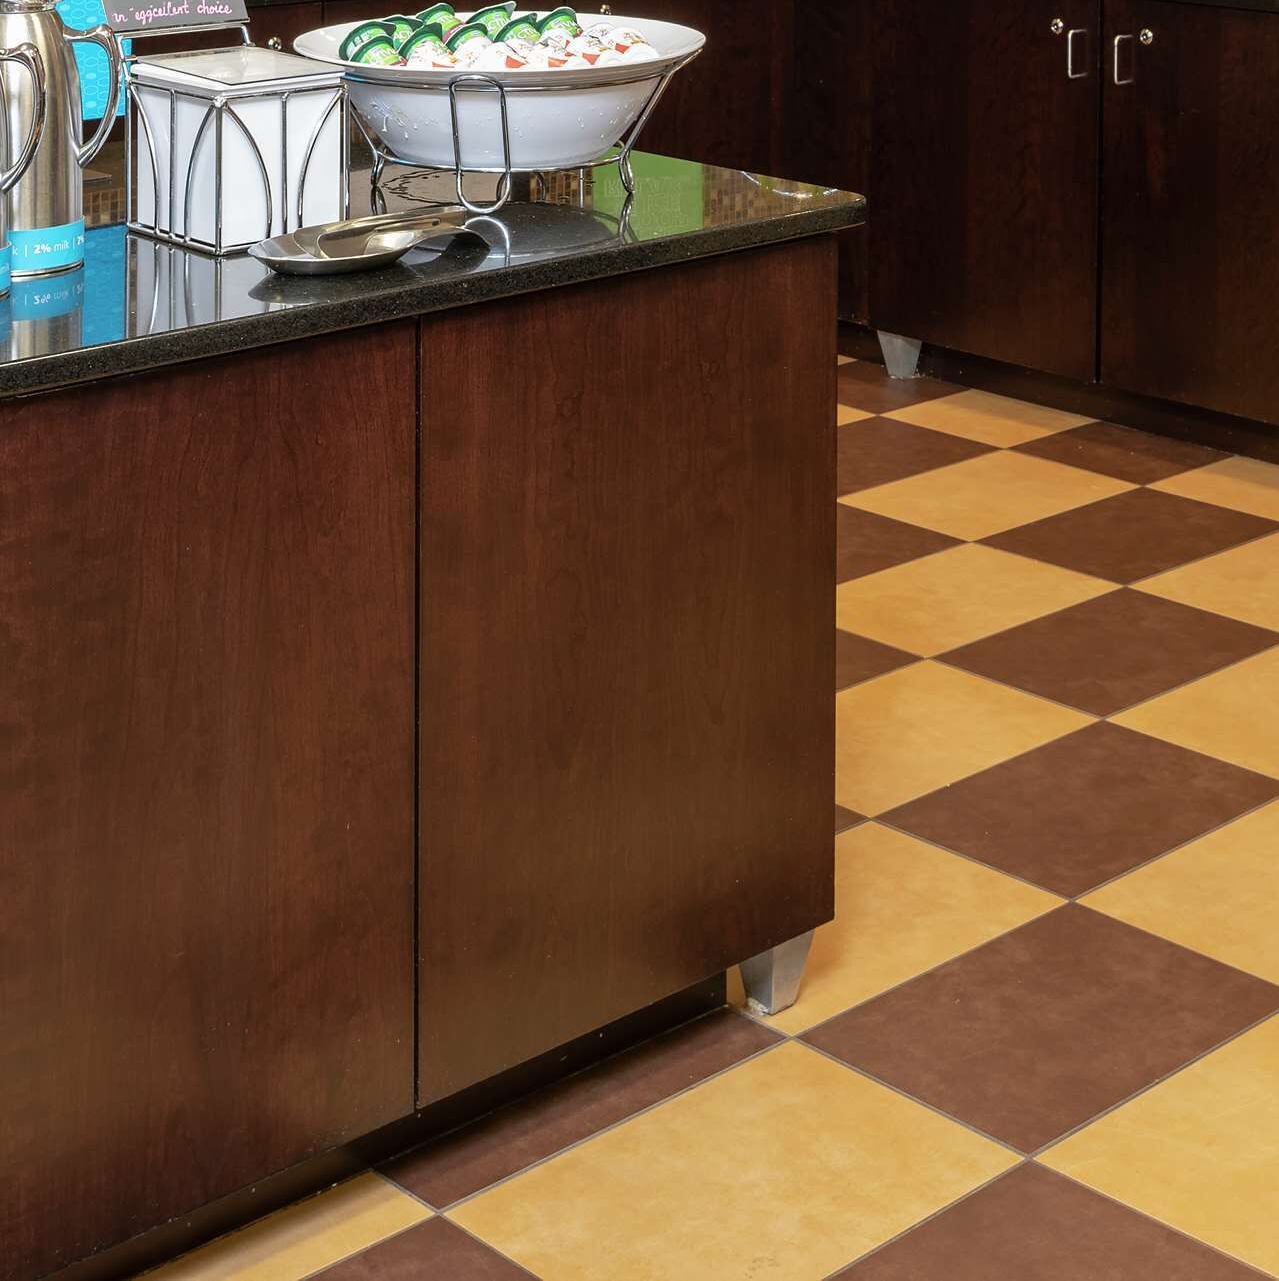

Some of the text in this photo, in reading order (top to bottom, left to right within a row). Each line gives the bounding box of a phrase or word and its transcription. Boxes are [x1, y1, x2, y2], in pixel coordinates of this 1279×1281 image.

[197, 0, 233, 15] choice
[33, 243, 51, 255] 2%
[53, 240, 70, 252] milk
